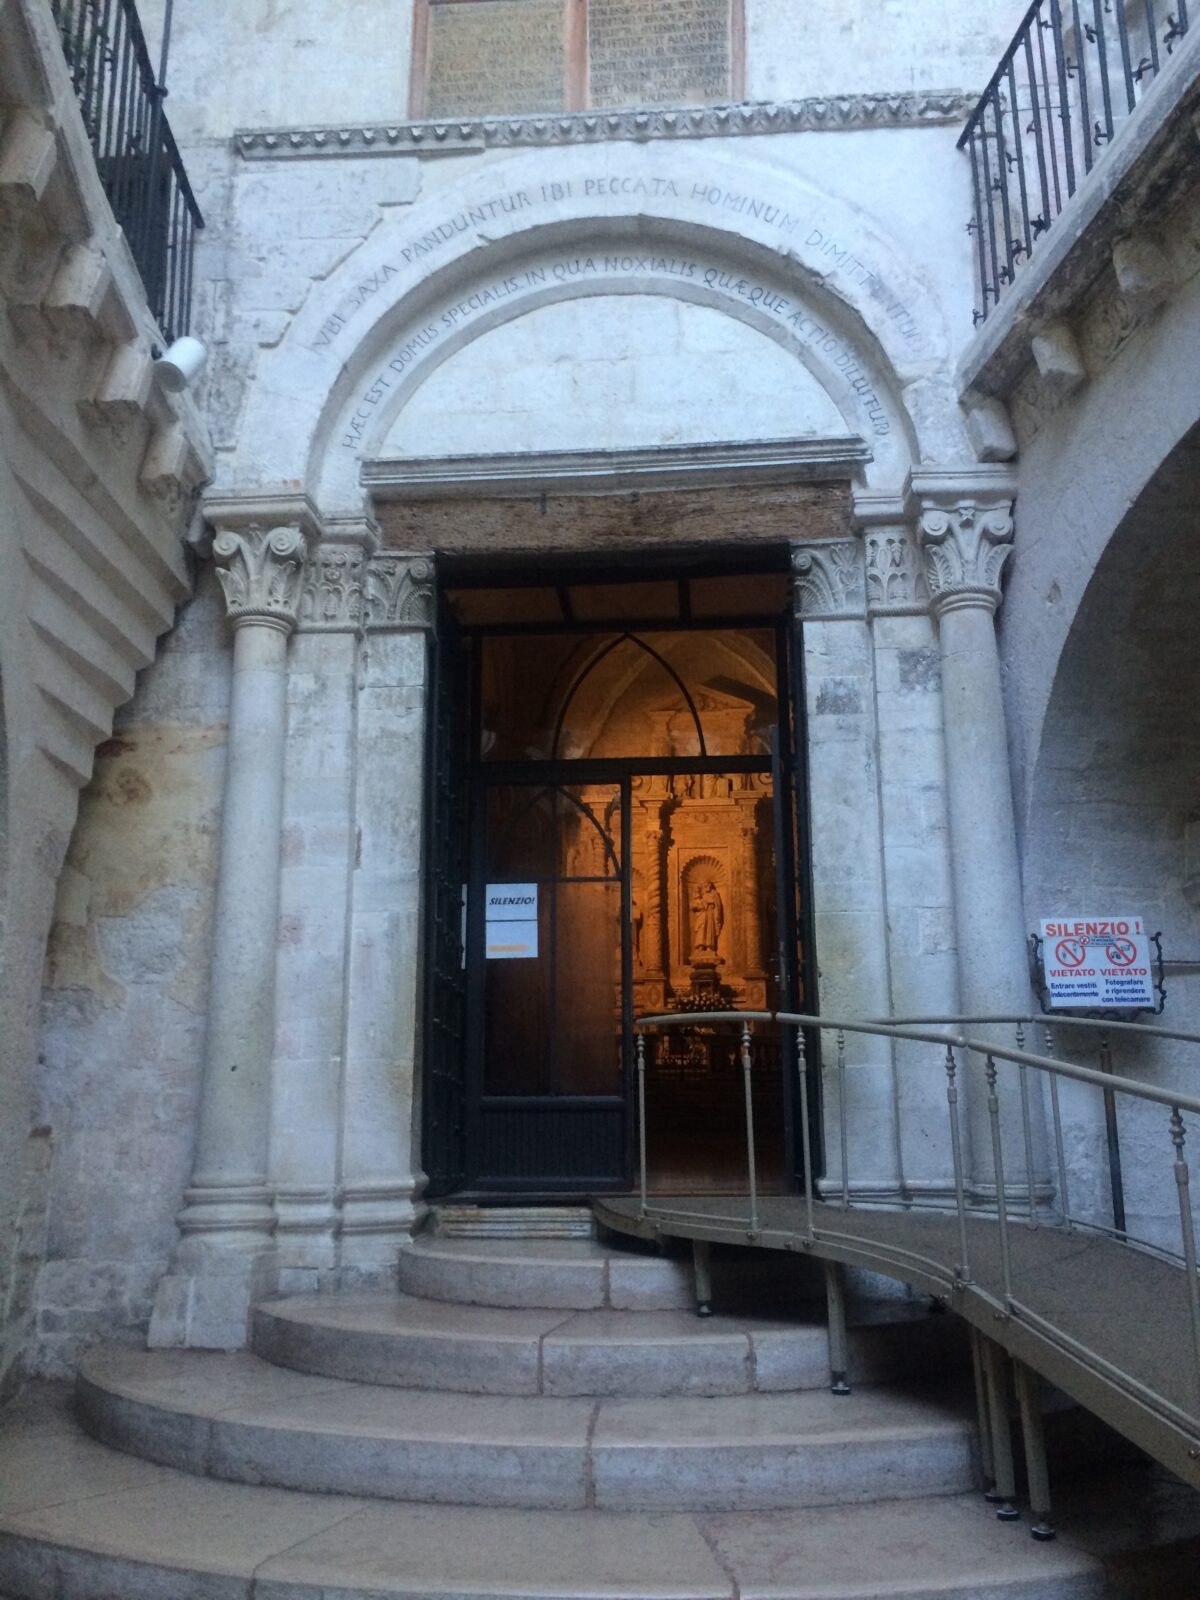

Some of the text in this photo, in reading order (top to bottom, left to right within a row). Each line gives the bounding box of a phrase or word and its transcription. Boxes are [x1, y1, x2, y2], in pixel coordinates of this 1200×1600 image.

[401, 192, 531, 262] PANDUNTUR
[541, 181, 572, 201] IBI
[584, 177, 678, 197] PECCATA
[691, 183, 799, 233] HOMINUM
[363, 373, 390, 404] EST
[389, 327, 439, 373] DOMUS
[441, 276, 518, 328] SPECIALIS
[525, 267, 547, 286] IN
[552, 257, 597, 281] QUA
[604, 255, 696, 277] NOXIALIS
[787, 311, 838, 352] ACTIO
[489, 897, 535, 905] SILENZIO!
[1049, 968, 1096, 977] VIETATO
[1099, 968, 1147, 976] VIETATO
[1076, 981, 1097, 989] vestiti
[1111, 987, 1145, 995] riprendere
